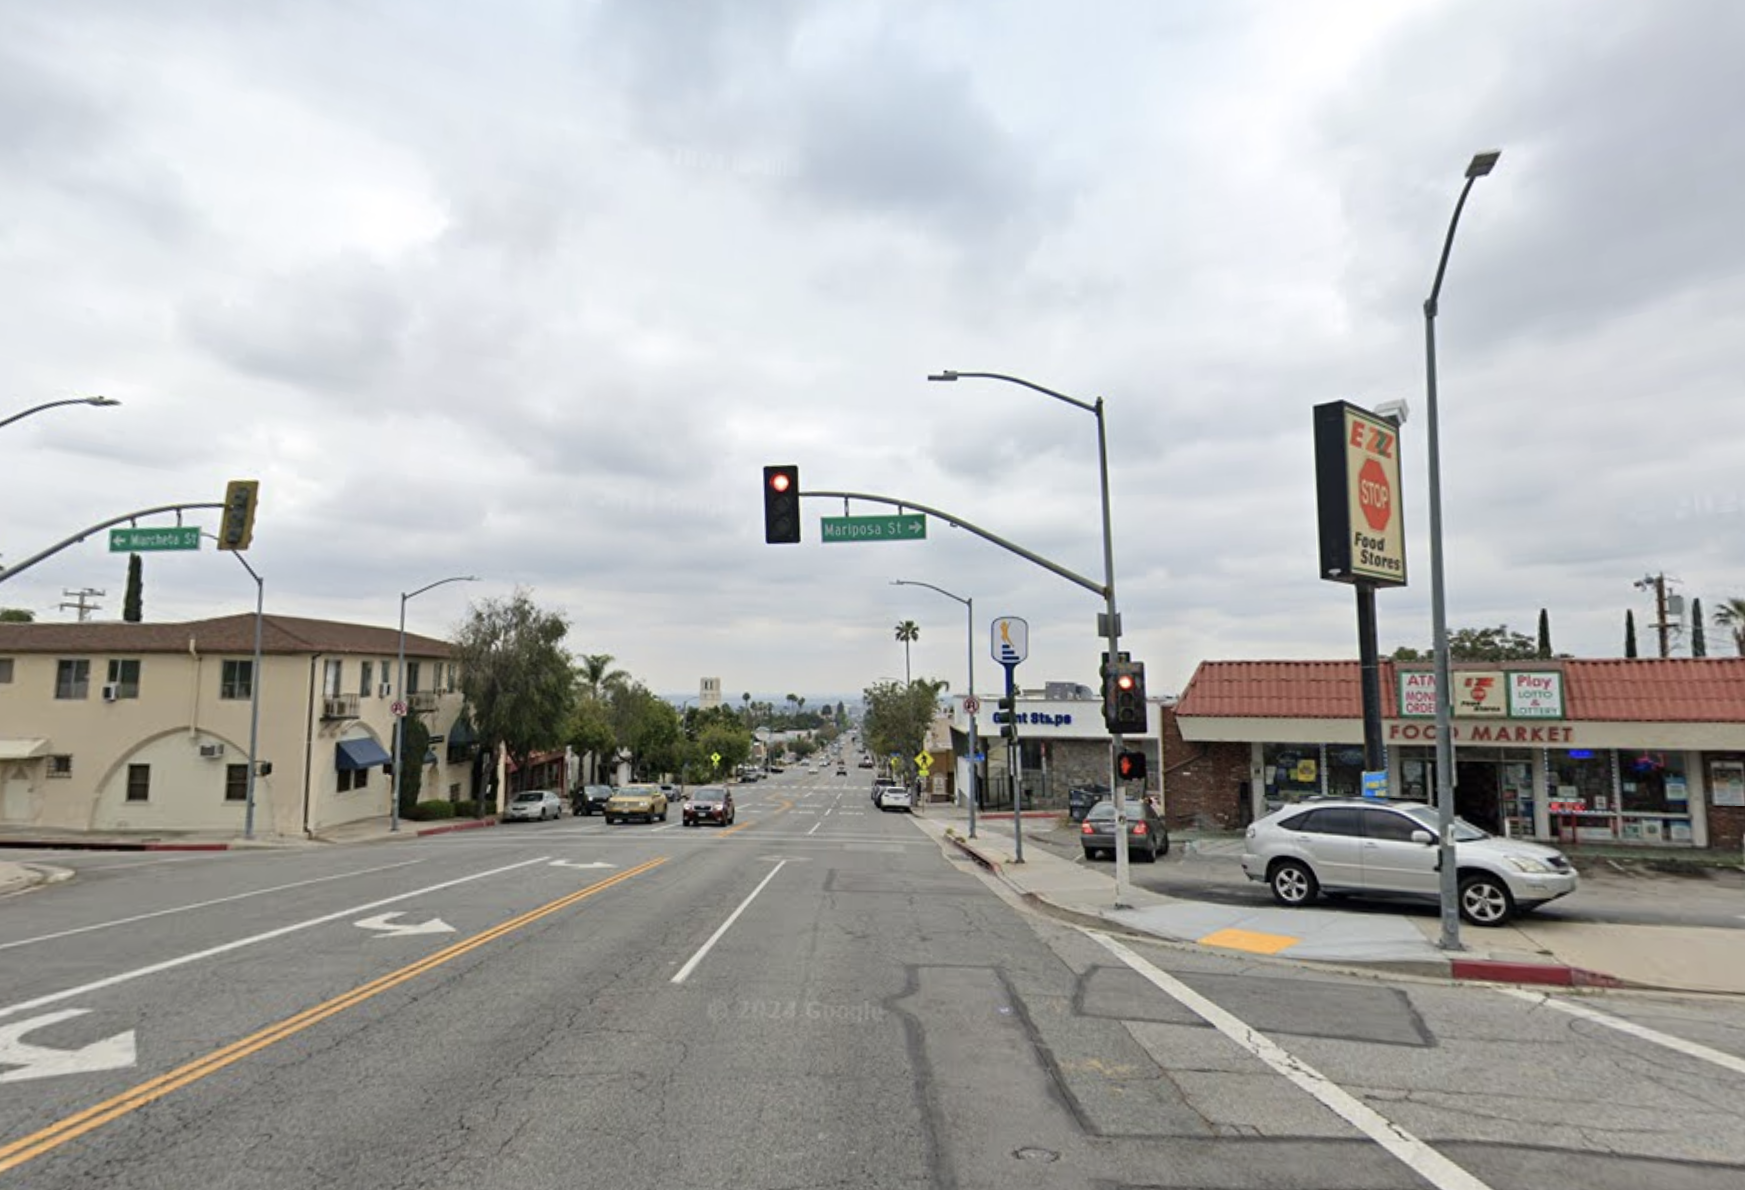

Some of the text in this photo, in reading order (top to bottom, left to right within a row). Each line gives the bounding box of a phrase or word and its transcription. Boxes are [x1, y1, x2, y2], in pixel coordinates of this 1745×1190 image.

[1361, 480, 1388, 508] STOP
[824, 521, 902, 537] Mariposa St
[184, 532, 197, 545] St
[1354, 532, 1385, 551] Food
[1360, 550, 1400, 570] Stores
[1517, 674, 1552, 690] Play
[1518, 690, 1553, 699] LOTTO
[1471, 726, 1573, 742] MARKET
